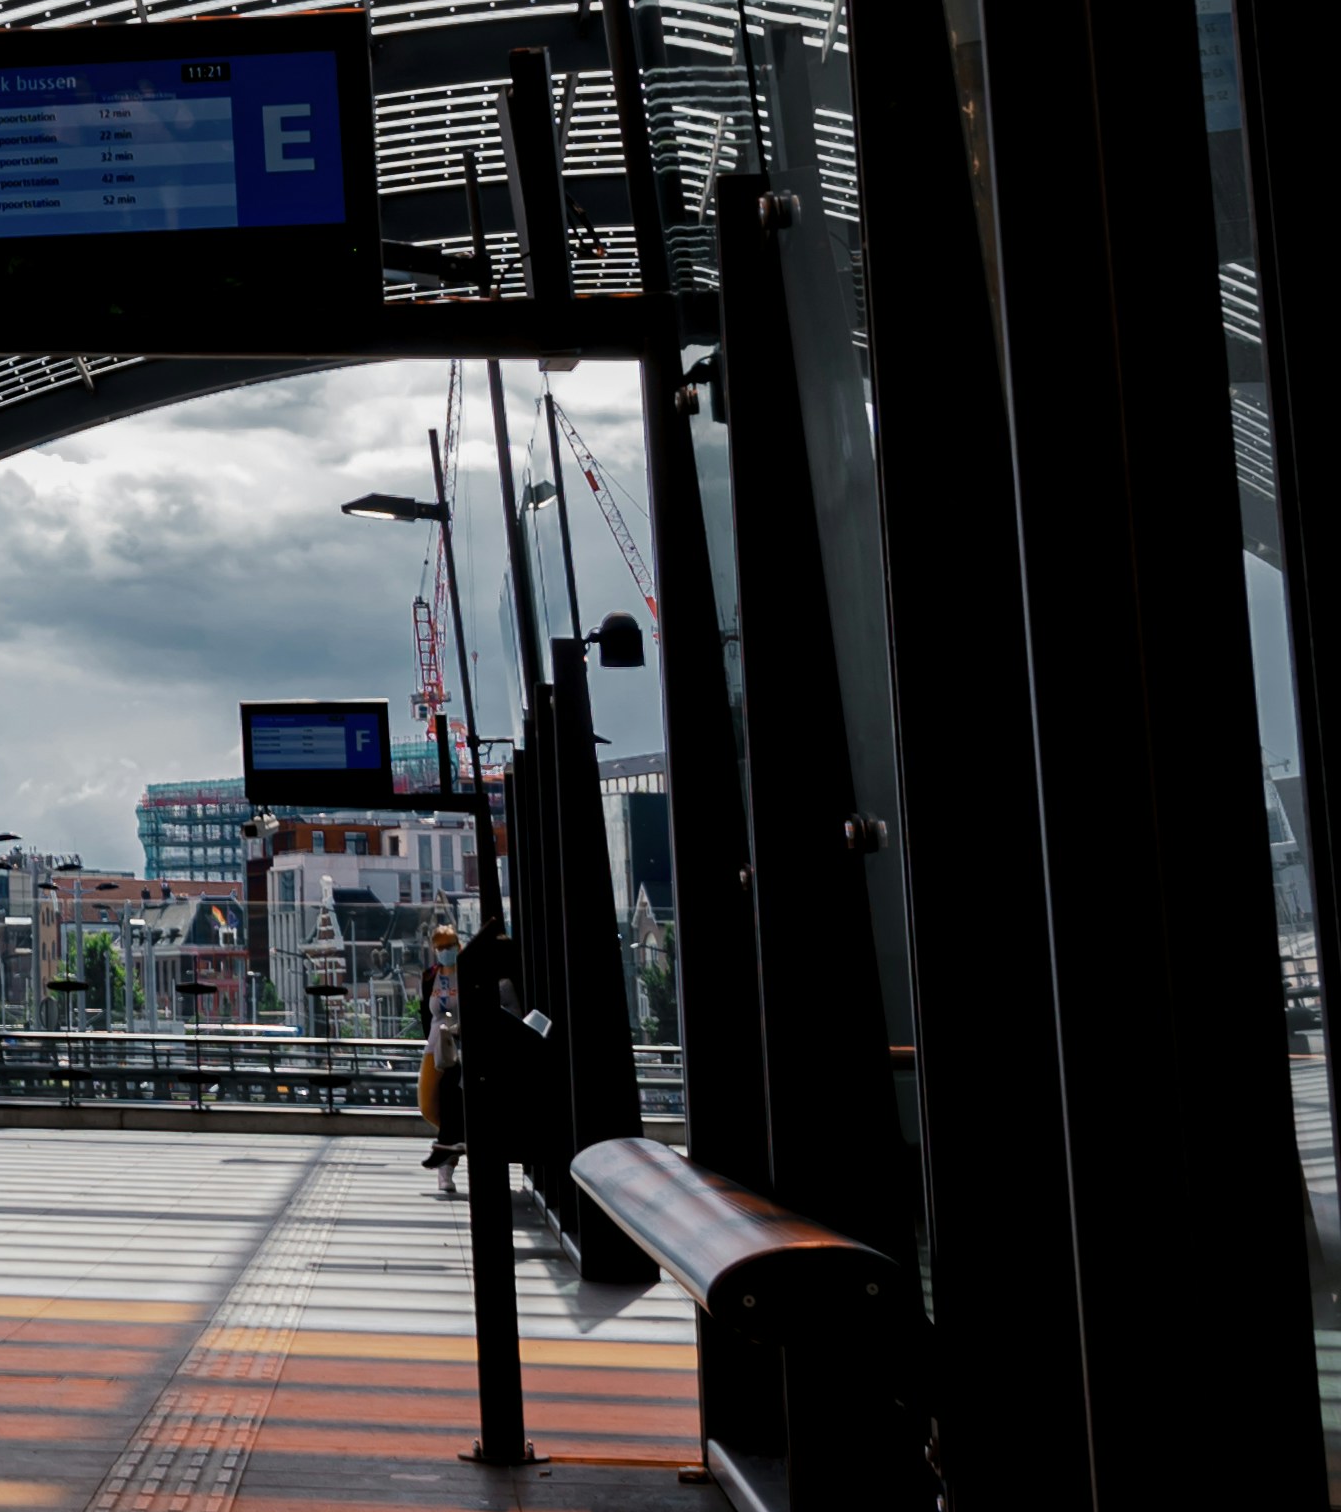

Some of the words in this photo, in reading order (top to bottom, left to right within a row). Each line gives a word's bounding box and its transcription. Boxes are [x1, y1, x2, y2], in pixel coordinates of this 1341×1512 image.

[187, 65, 223, 79] 11:21
[16, 74, 77, 92] bussen
[99, 109, 111, 119] 12
[113, 108, 131, 118] min
[99, 130, 112, 141] 22
[114, 129, 133, 140] min
[262, 103, 315, 173] E
[100, 151, 113, 162] 32
[115, 150, 134, 161] min
[101, 173, 114, 183] 42
[116, 172, 135, 183] min
[103, 195, 115, 205] 52
[117, 193, 136, 204] min
[355, 729, 372, 752] F
